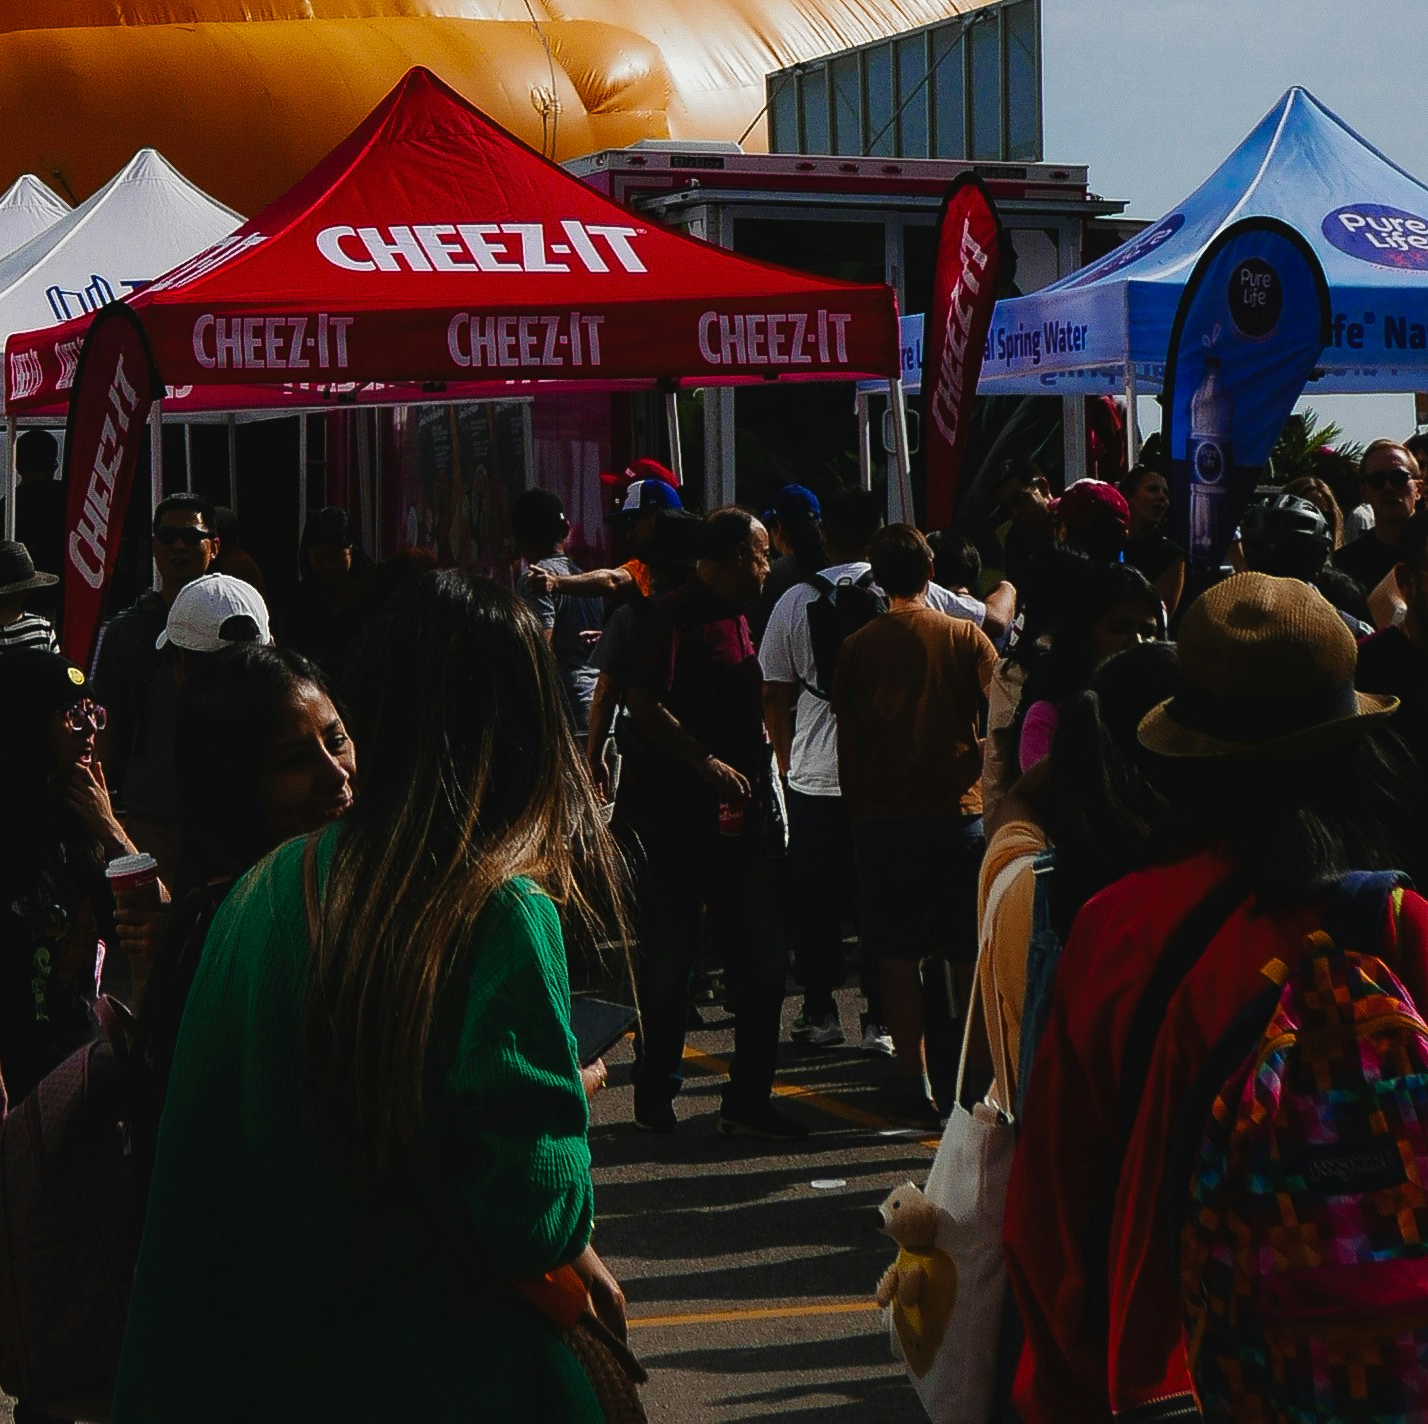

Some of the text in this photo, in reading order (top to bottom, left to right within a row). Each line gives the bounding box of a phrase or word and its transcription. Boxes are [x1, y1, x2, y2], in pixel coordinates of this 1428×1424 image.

[316, 219, 649, 274] CHEEZ-IT
[1337, 212, 1428, 237] Pure
[1366, 231, 1428, 252] Life
[1240, 267, 1271, 288] Pure
[1243, 287, 1267, 308] Life
[192, 313, 355, 369] CHEEZ-IT
[447, 311, 606, 368] CHEEZ-IT
[698, 309, 853, 365] CHEEZ-IT
[932, 217, 988, 446] CHEEZIT
[997, 323, 1041, 367] Spring
[1042, 320, 1088, 356] Water
[68, 353, 140, 590] CHEEZIT
